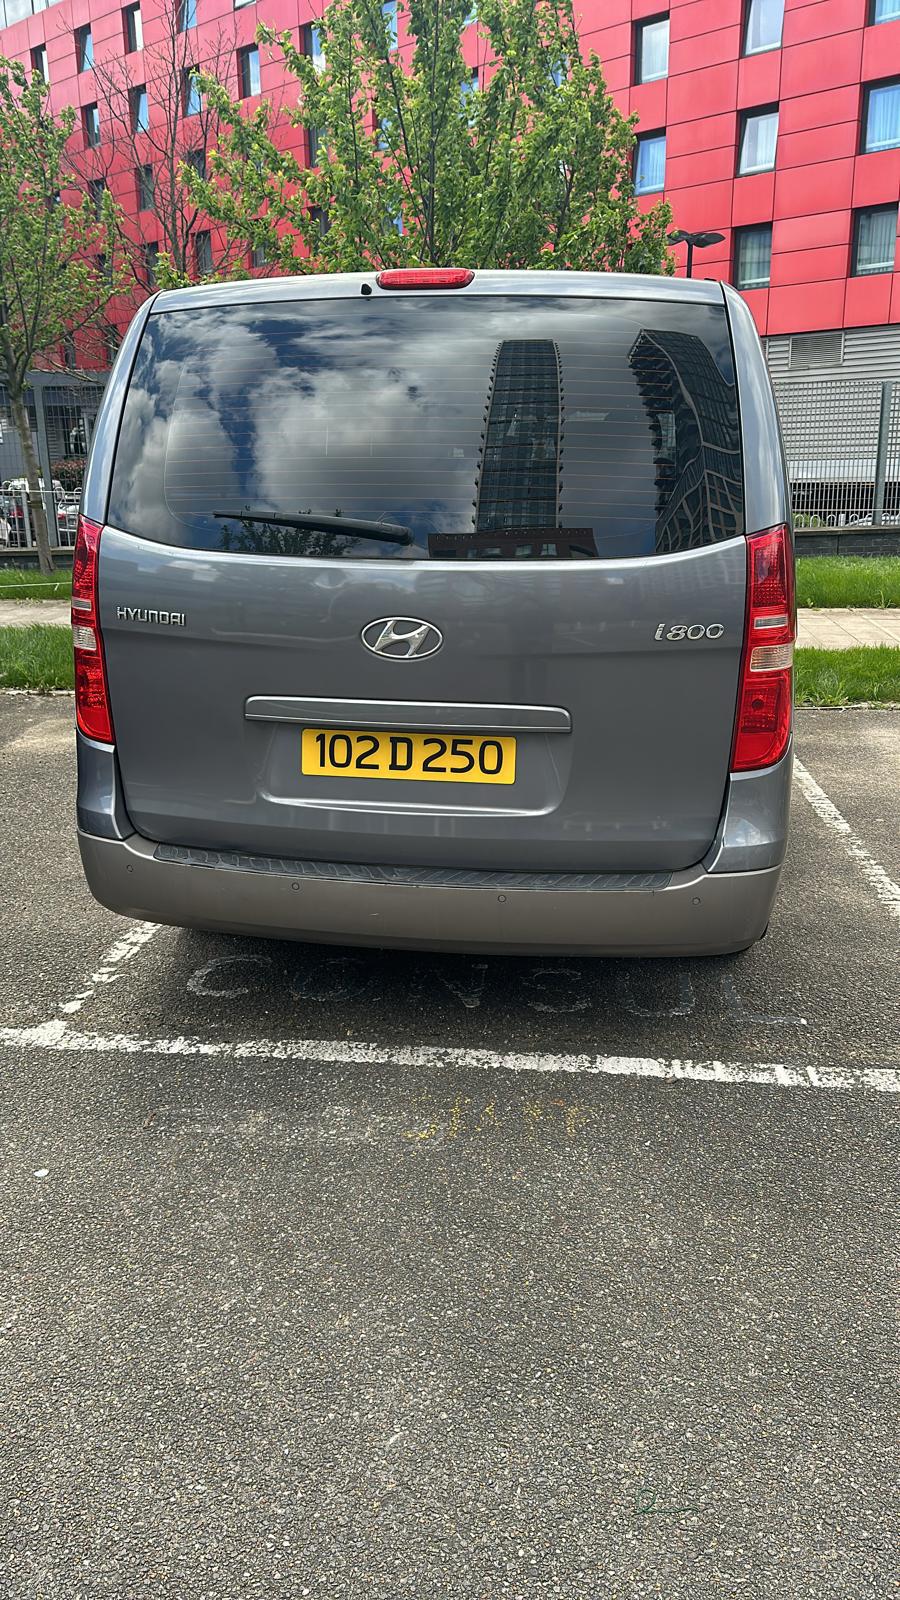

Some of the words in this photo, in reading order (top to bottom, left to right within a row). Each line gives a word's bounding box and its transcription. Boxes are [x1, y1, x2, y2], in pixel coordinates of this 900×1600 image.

[116, 606, 186, 626] HYUNDAI
[654, 623, 725, 641] i800
[315, 733, 380, 770] 102
[388, 736, 413, 771] D
[422, 737, 504, 775] 250
